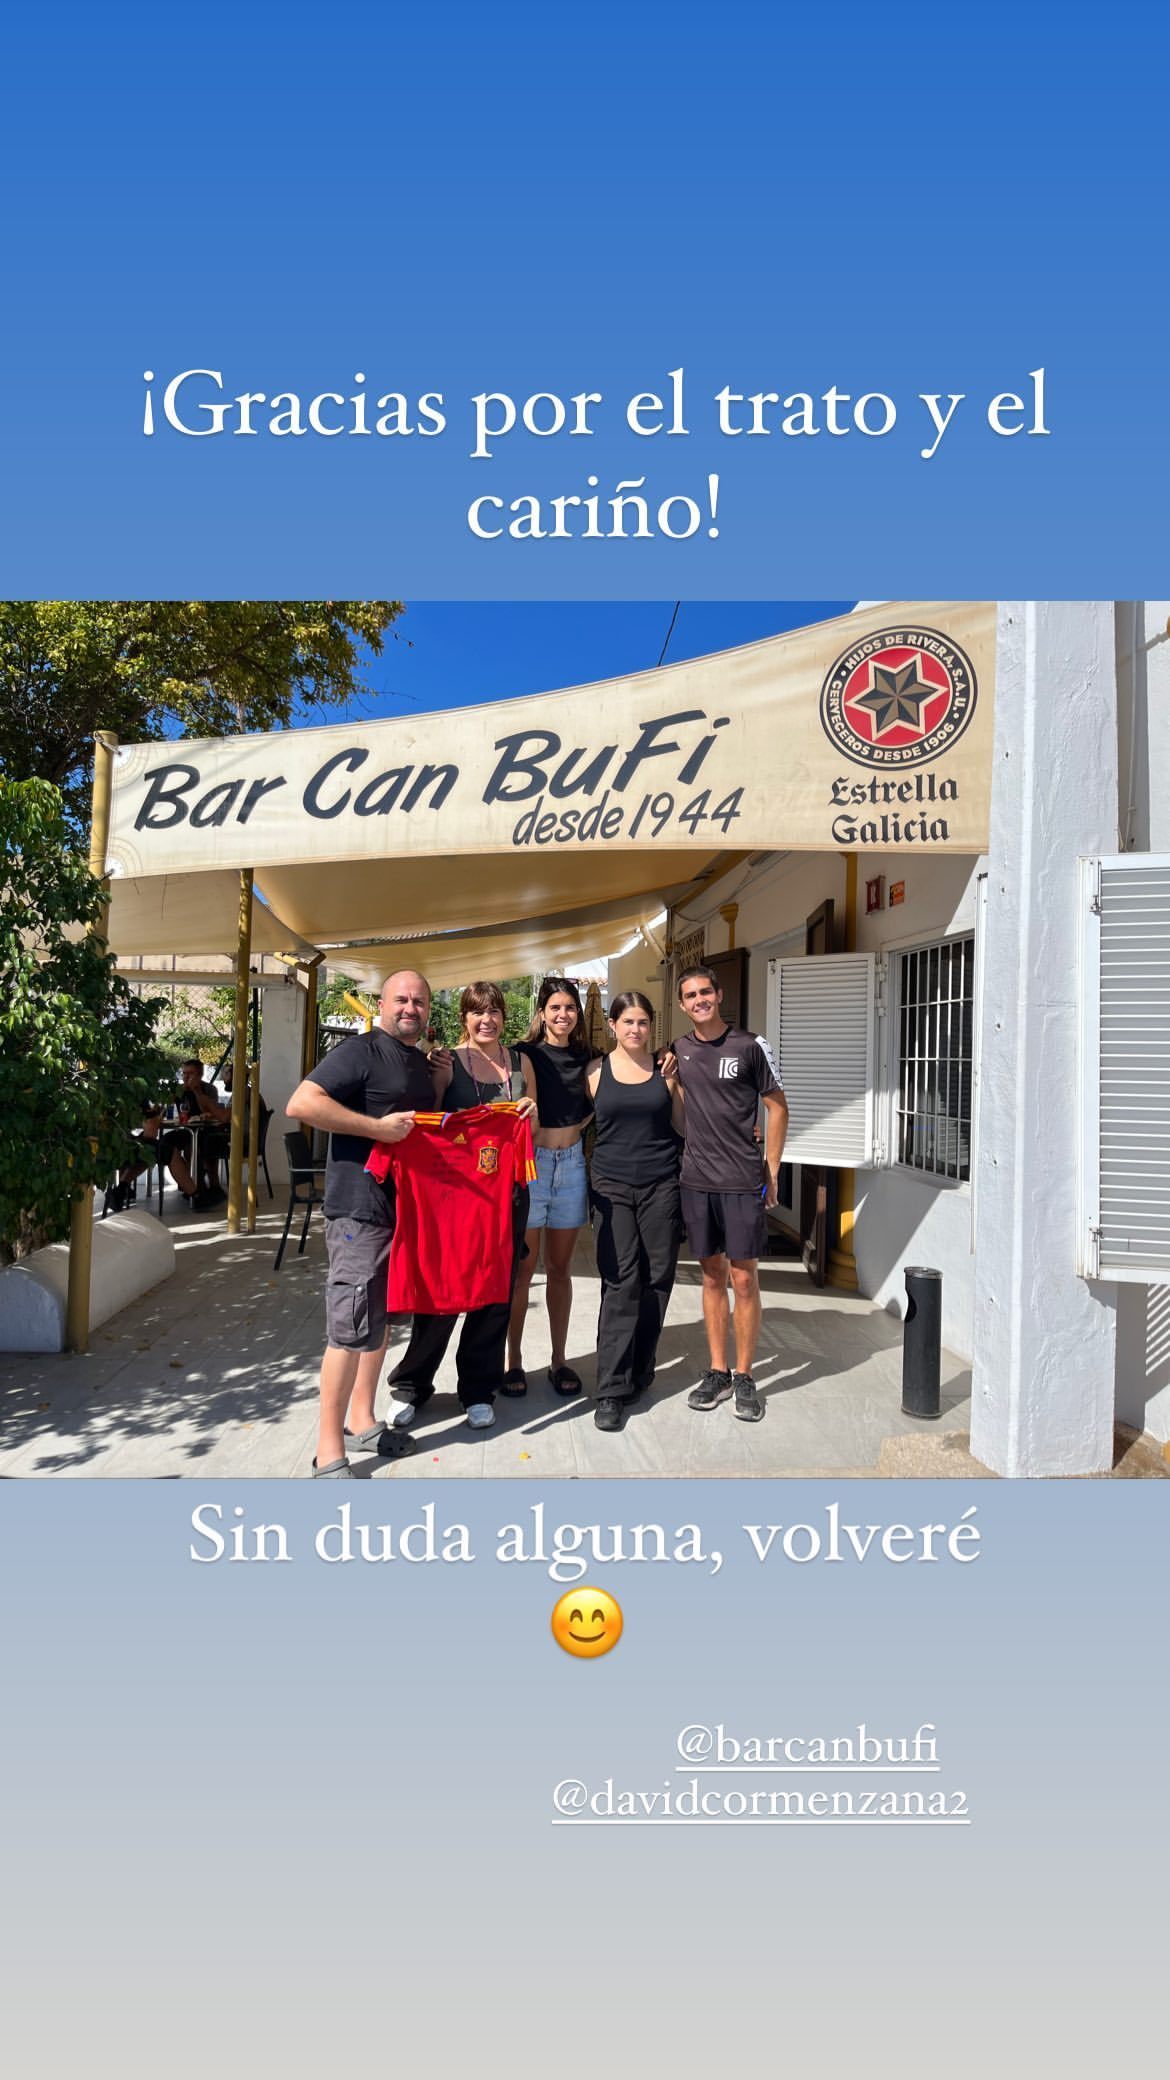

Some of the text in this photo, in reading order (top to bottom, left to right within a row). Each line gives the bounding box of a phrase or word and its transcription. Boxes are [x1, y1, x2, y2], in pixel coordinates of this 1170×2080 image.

[844, 639, 882, 671] HIJOS
[885, 634, 904, 645] DE
[907, 634, 954, 669] RIVERA,
[829, 680, 955, 761] CERVECEROS DESDE 1906
[134, 763, 287, 832] Bar
[303, 747, 459, 819] Can
[829, 773, 959, 807] Estrella
[512, 787, 745, 846] desde 1944
[831, 812, 951, 845] Galicia
